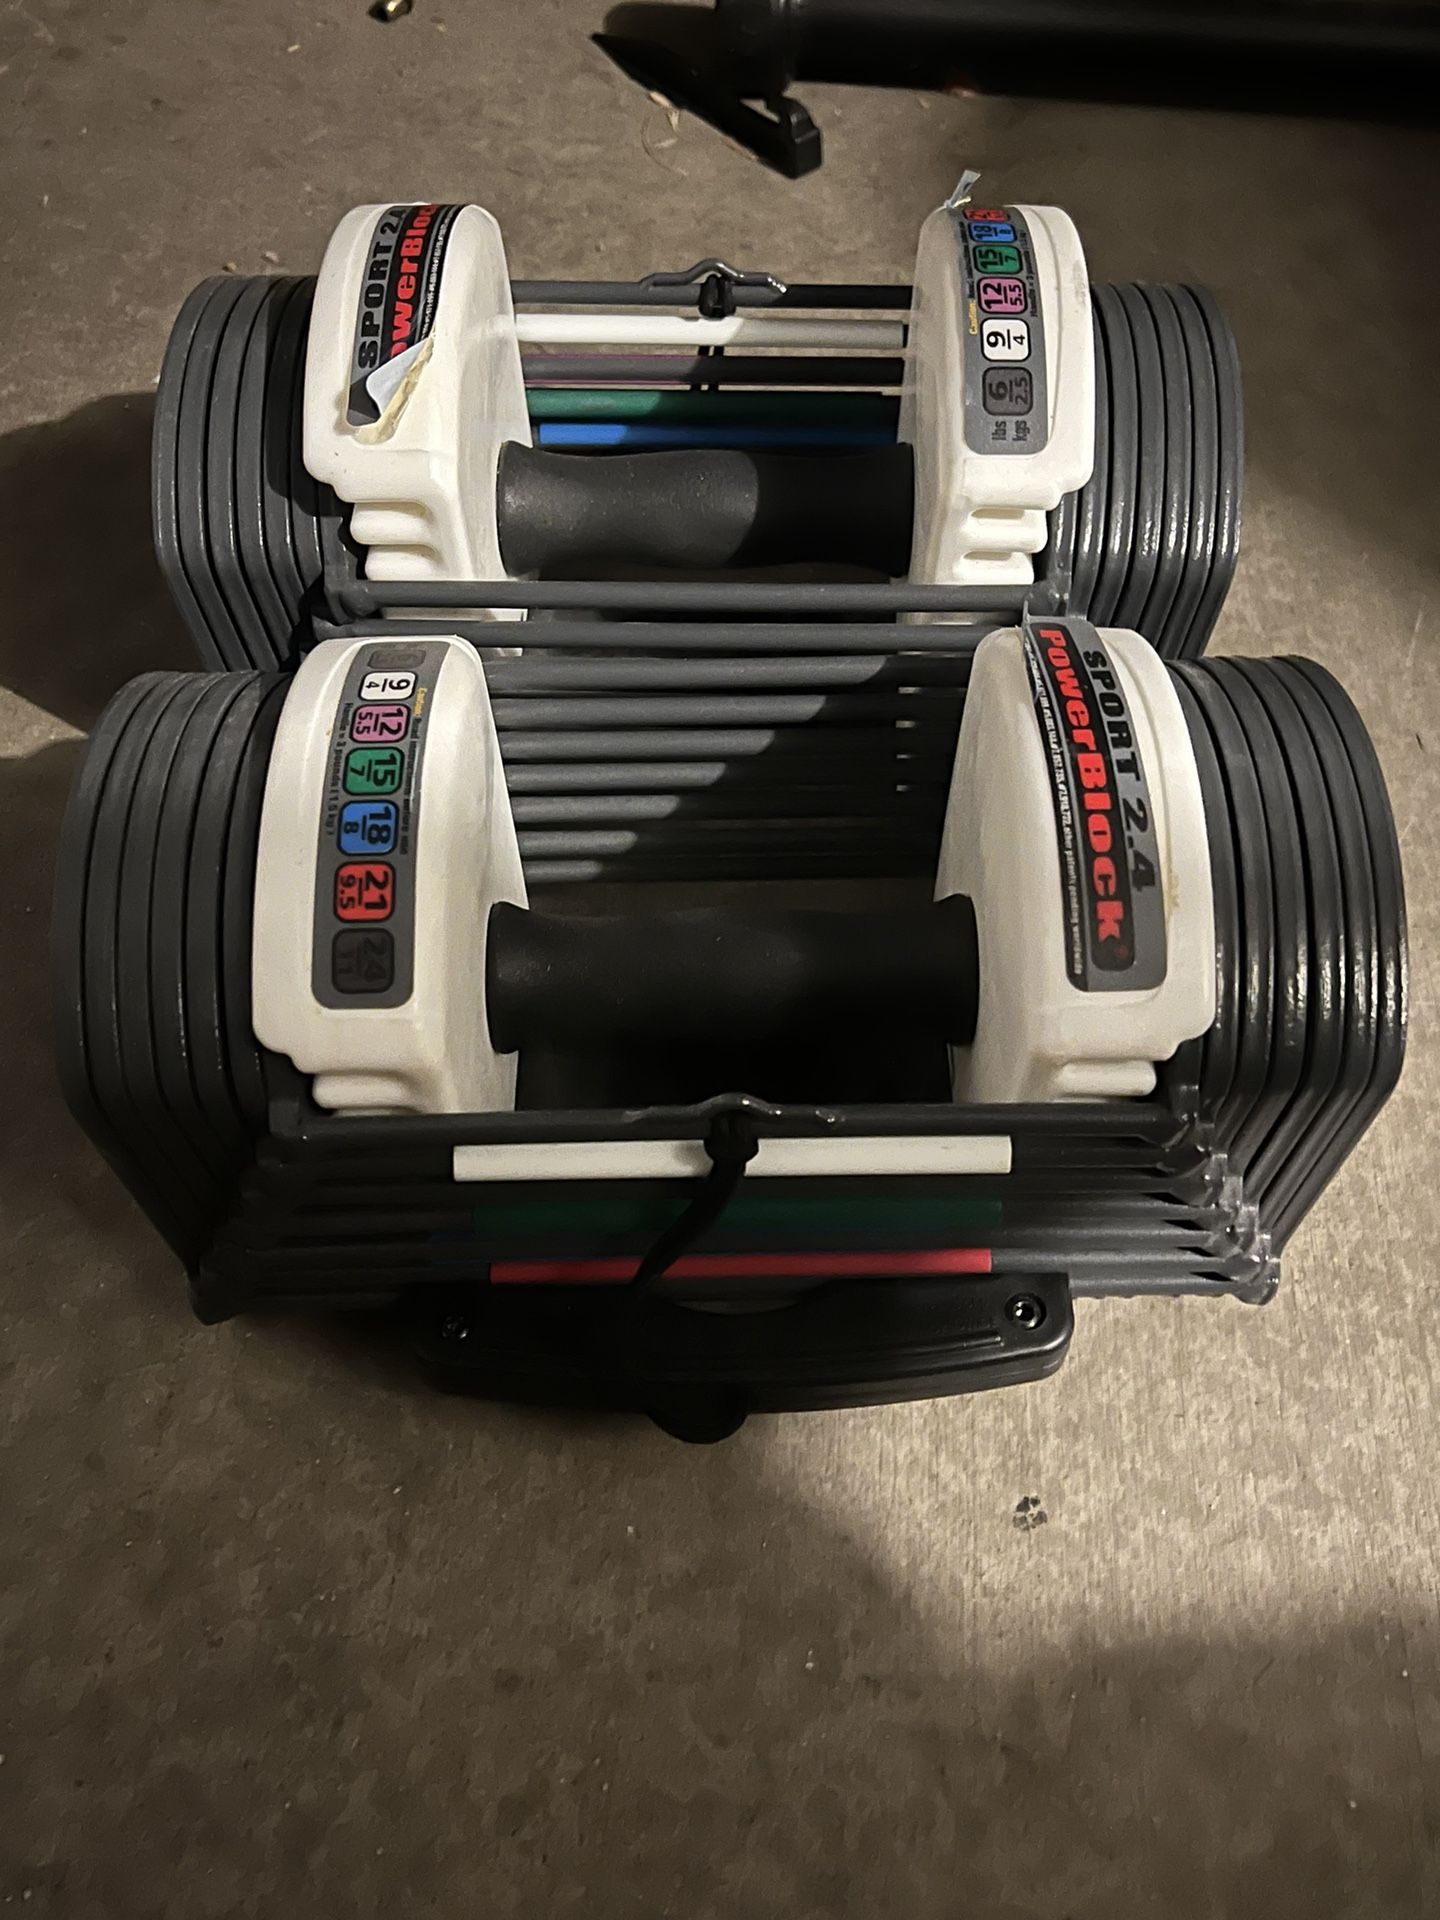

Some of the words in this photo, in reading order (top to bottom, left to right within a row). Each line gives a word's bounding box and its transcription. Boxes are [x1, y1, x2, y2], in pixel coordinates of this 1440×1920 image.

[973, 224, 993, 240] 18
[979, 248, 999, 269] 15
[1004, 254, 1017, 264] 7
[390, 203, 439, 359] owerBloc
[357, 242, 391, 369] SPORT
[983, 282, 1003, 309] 12
[1010, 284, 1024, 306] 5.5
[986, 330, 1007, 348] 9
[1012, 334, 1026, 346] 4
[988, 380, 1009, 400] 6
[1015, 376, 1029, 405] 2.5
[992, 420, 1007, 441] lbs
[1012, 420, 1031, 442] kgs
[365, 680, 380, 689] 4
[388, 678, 411, 690] 9
[355, 711, 373, 735] 5.5
[378, 708, 404, 736] 12
[349, 766, 366, 777] 7
[372, 753, 397, 787] 15
[1082, 650, 1141, 782] SPORT
[1122, 796, 1156, 893] 2.4
[1039, 629, 1125, 944] PowerBlock
[343, 821, 359, 834] 8
[367, 806, 393, 845] 18
[339, 875, 356, 909] 9.5
[363, 870, 389, 911] 21
